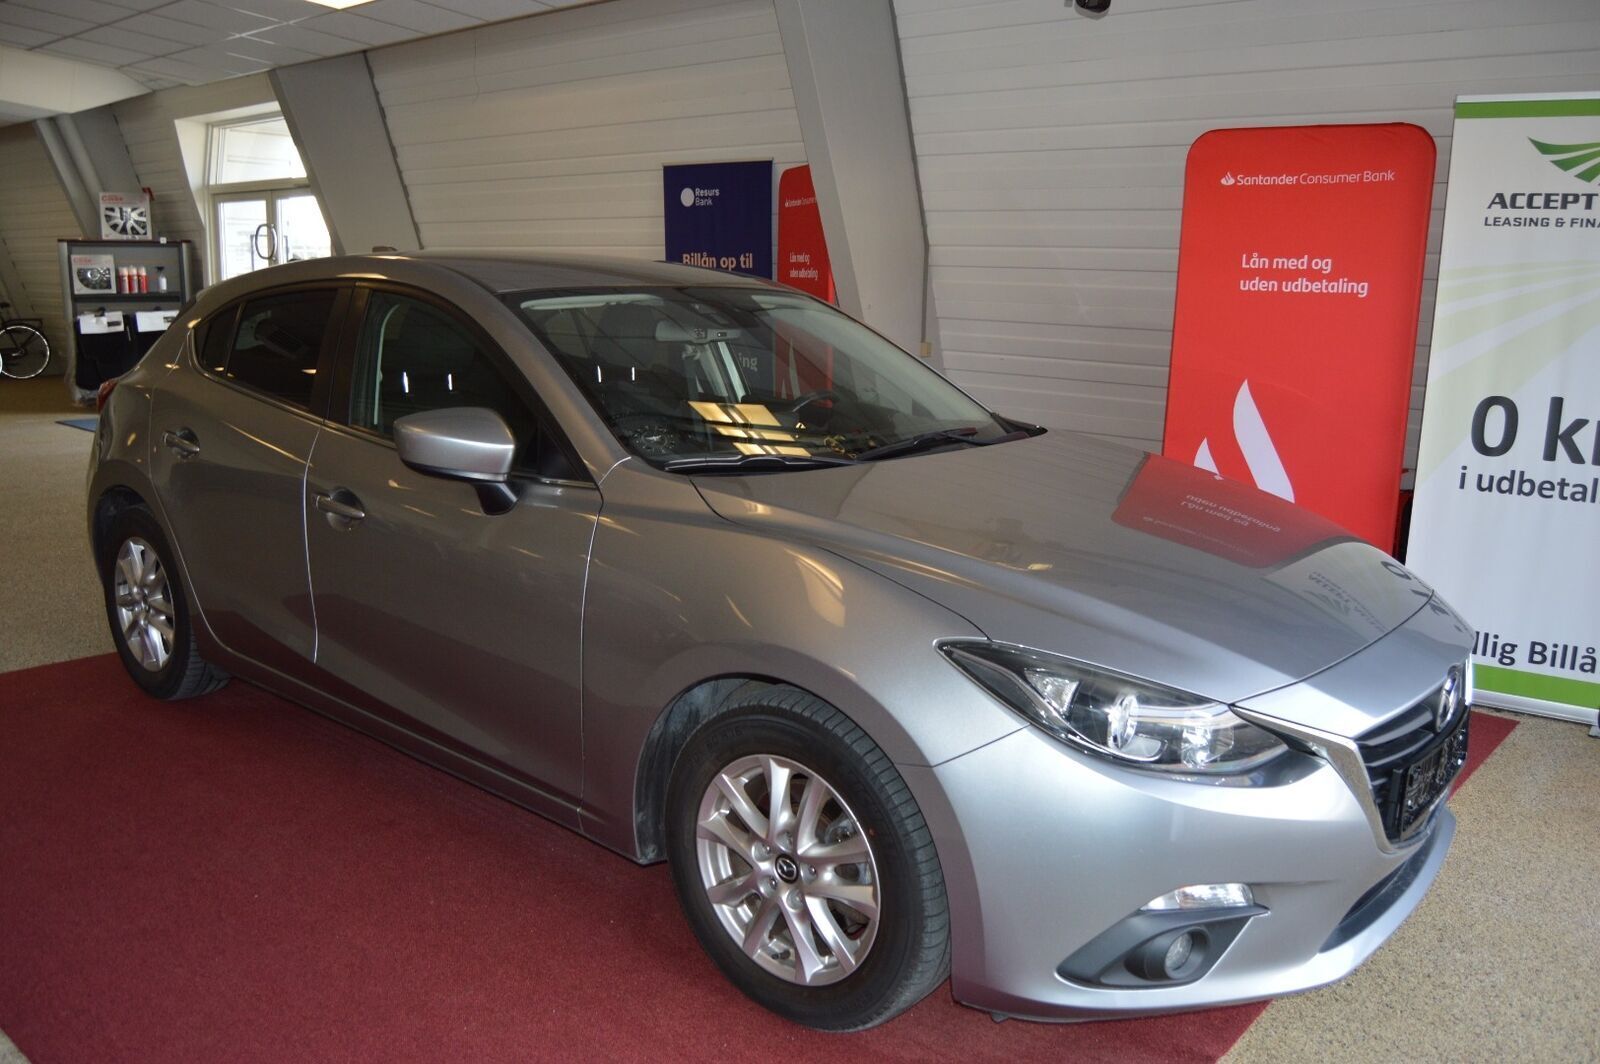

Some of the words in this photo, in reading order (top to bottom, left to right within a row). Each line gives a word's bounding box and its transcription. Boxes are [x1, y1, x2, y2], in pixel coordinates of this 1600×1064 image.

[1237, 173, 1298, 186] Santander
[1299, 172, 1361, 185] Consumer
[1363, 169, 1395, 182] Bank
[695, 187, 720, 198] Resurs
[695, 197, 713, 207] Bank
[1487, 192, 1599, 210] ACCEPT
[1484, 216, 1550, 228] LEASING
[1555, 217, 1566, 228] &
[1570, 218, 1600, 228] FIN
[682, 252, 717, 268] Billån
[720, 257, 736, 271] op
[740, 252, 753, 269] til
[1241, 253, 1268, 269] Lån
[1272, 255, 1308, 270] med
[1312, 257, 1332, 273] og
[1239, 277, 1278, 291] uden
[1282, 278, 1368, 297] udbetaling
[1471, 395, 1519, 457] 0
[1459, 465, 1468, 490] i
[1528, 640, 1597, 674] Billå
